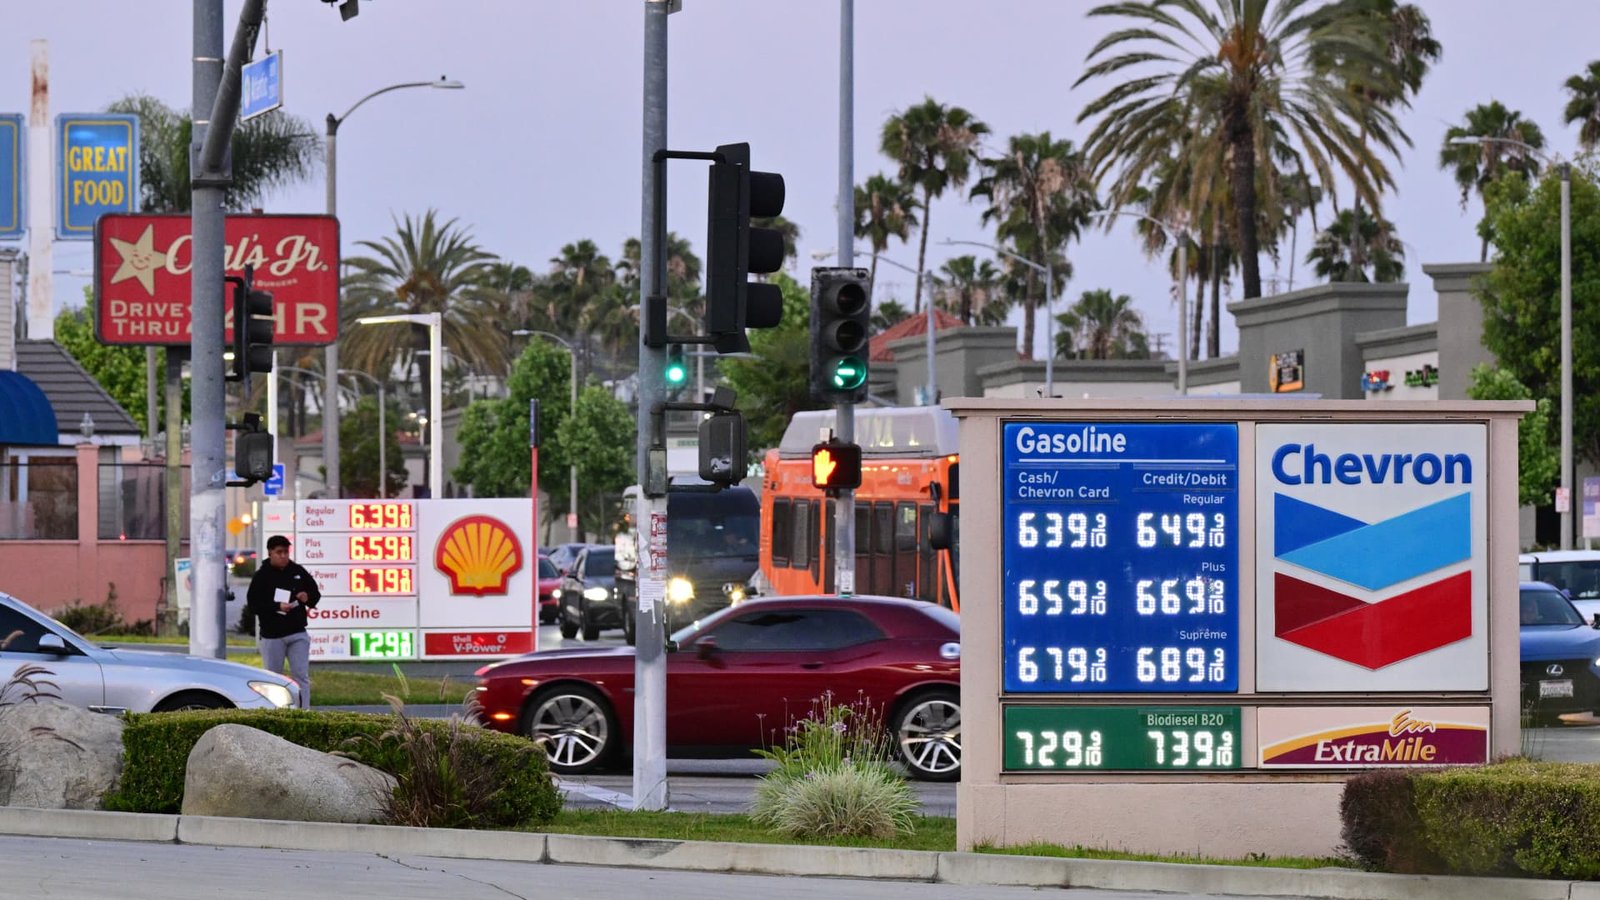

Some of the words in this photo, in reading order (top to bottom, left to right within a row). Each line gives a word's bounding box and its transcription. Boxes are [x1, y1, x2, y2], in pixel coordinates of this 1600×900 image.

[69, 146, 127, 172] GREAT
[73, 180, 124, 205] FOOD
[165, 233, 269, 275] Cl's
[269, 235, 329, 276] Jr.
[110, 300, 183, 317] DRIVE
[113, 318, 180, 336] THRU
[1016, 425, 1127, 454] Gasoline
[1271, 443, 1472, 486] Chevron
[1018, 471, 1059, 484] Cash/
[1142, 472, 1228, 486] Credit/Debit
[1018, 486, 1074, 498] Chevron
[1078, 486, 1110, 498] Card
[1183, 494, 1225, 506] Regular
[305, 506, 335, 516] Regular
[305, 518, 324, 526] Cash
[305, 539, 321, 547] Plus
[305, 550, 324, 559] Cash
[1201, 562, 1226, 572] Plus
[309, 571, 337, 579] -Power
[307, 605, 380, 619] Gasoline
[308, 635, 329, 643] iesel
[452, 635, 472, 643] Shell
[309, 647, 325, 655] ash
[453, 643, 502, 653] V-Power
[1147, 714, 1198, 726] Biodiesel
[1201, 714, 1224, 726] B20
[1314, 737, 1436, 762] ExtraMile
